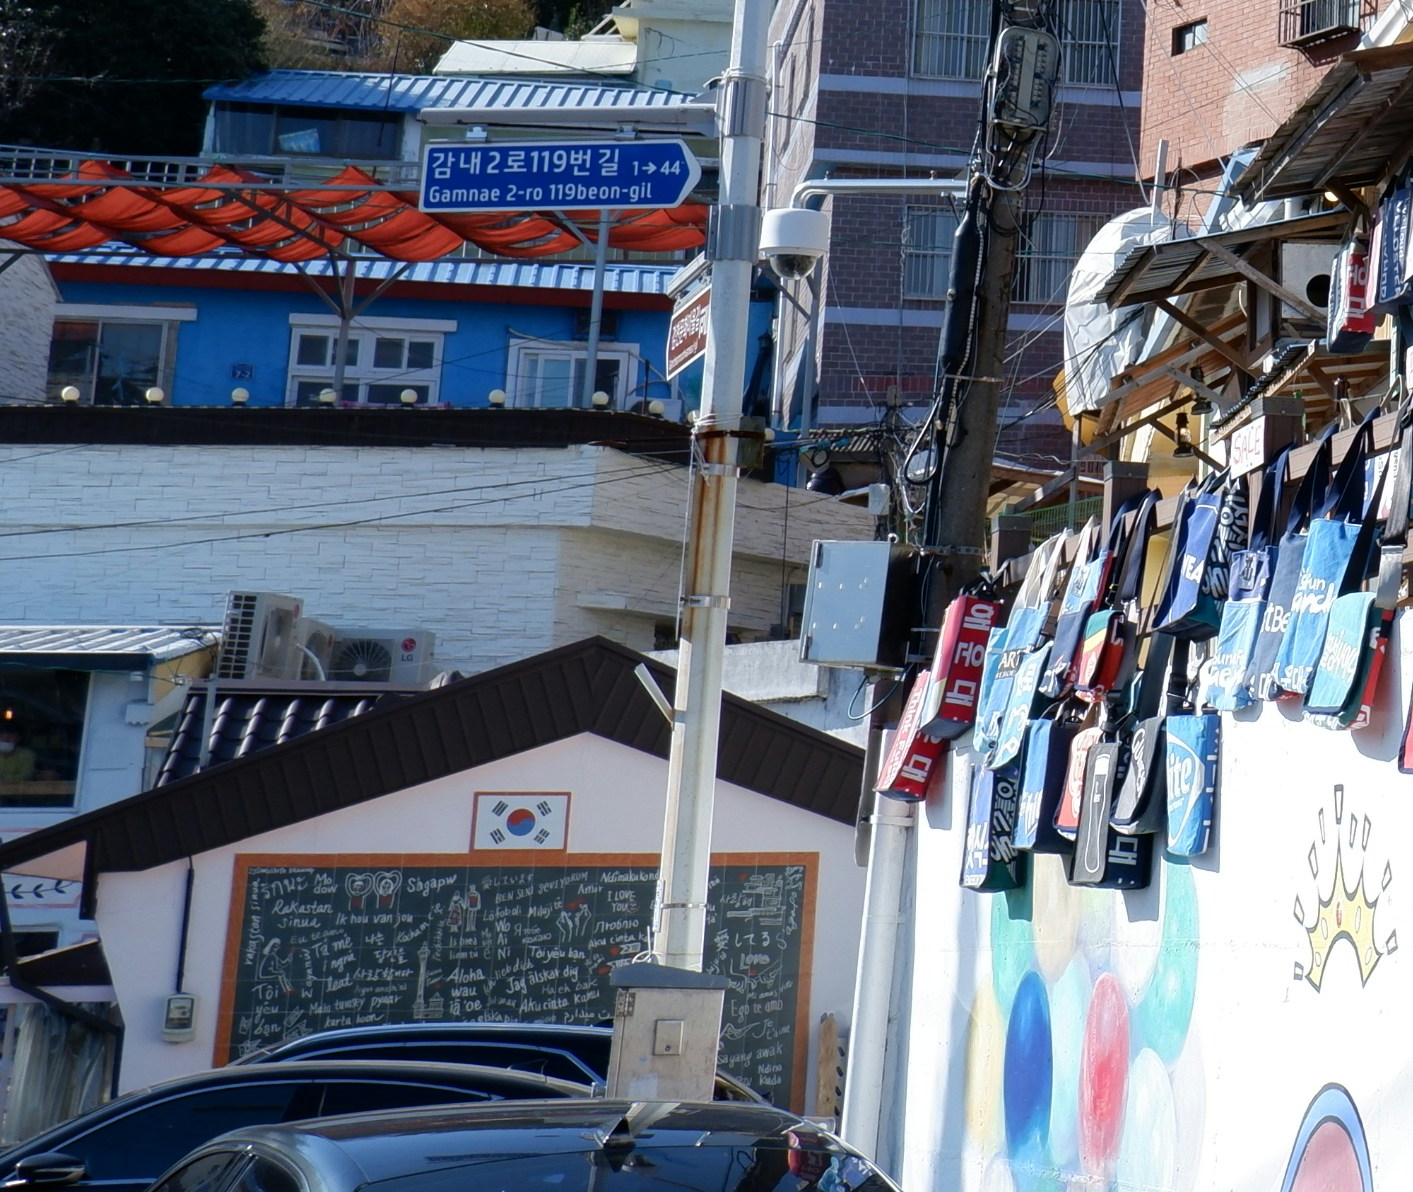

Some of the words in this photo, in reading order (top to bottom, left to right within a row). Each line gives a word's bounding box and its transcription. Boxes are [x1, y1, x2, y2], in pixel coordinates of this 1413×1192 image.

[660, 160, 681, 176] 44
[429, 185, 500, 203] Gamnae
[507, 185, 543, 202] 2-ro
[550, 182, 652, 203] 119beon-gil
[401, 654, 413, 662] LG
[614, 891, 636, 902] LOVE
[272, 899, 334, 915] Rakastan
[278, 915, 322, 928] sinua
[351, 913, 369, 924] hou
[373, 914, 393, 924] van
[446, 966, 486, 983] Aloha
[451, 986, 478, 997] wau
[730, 1001, 750, 1024] Ego
[757, 1041, 783, 1060] awak
